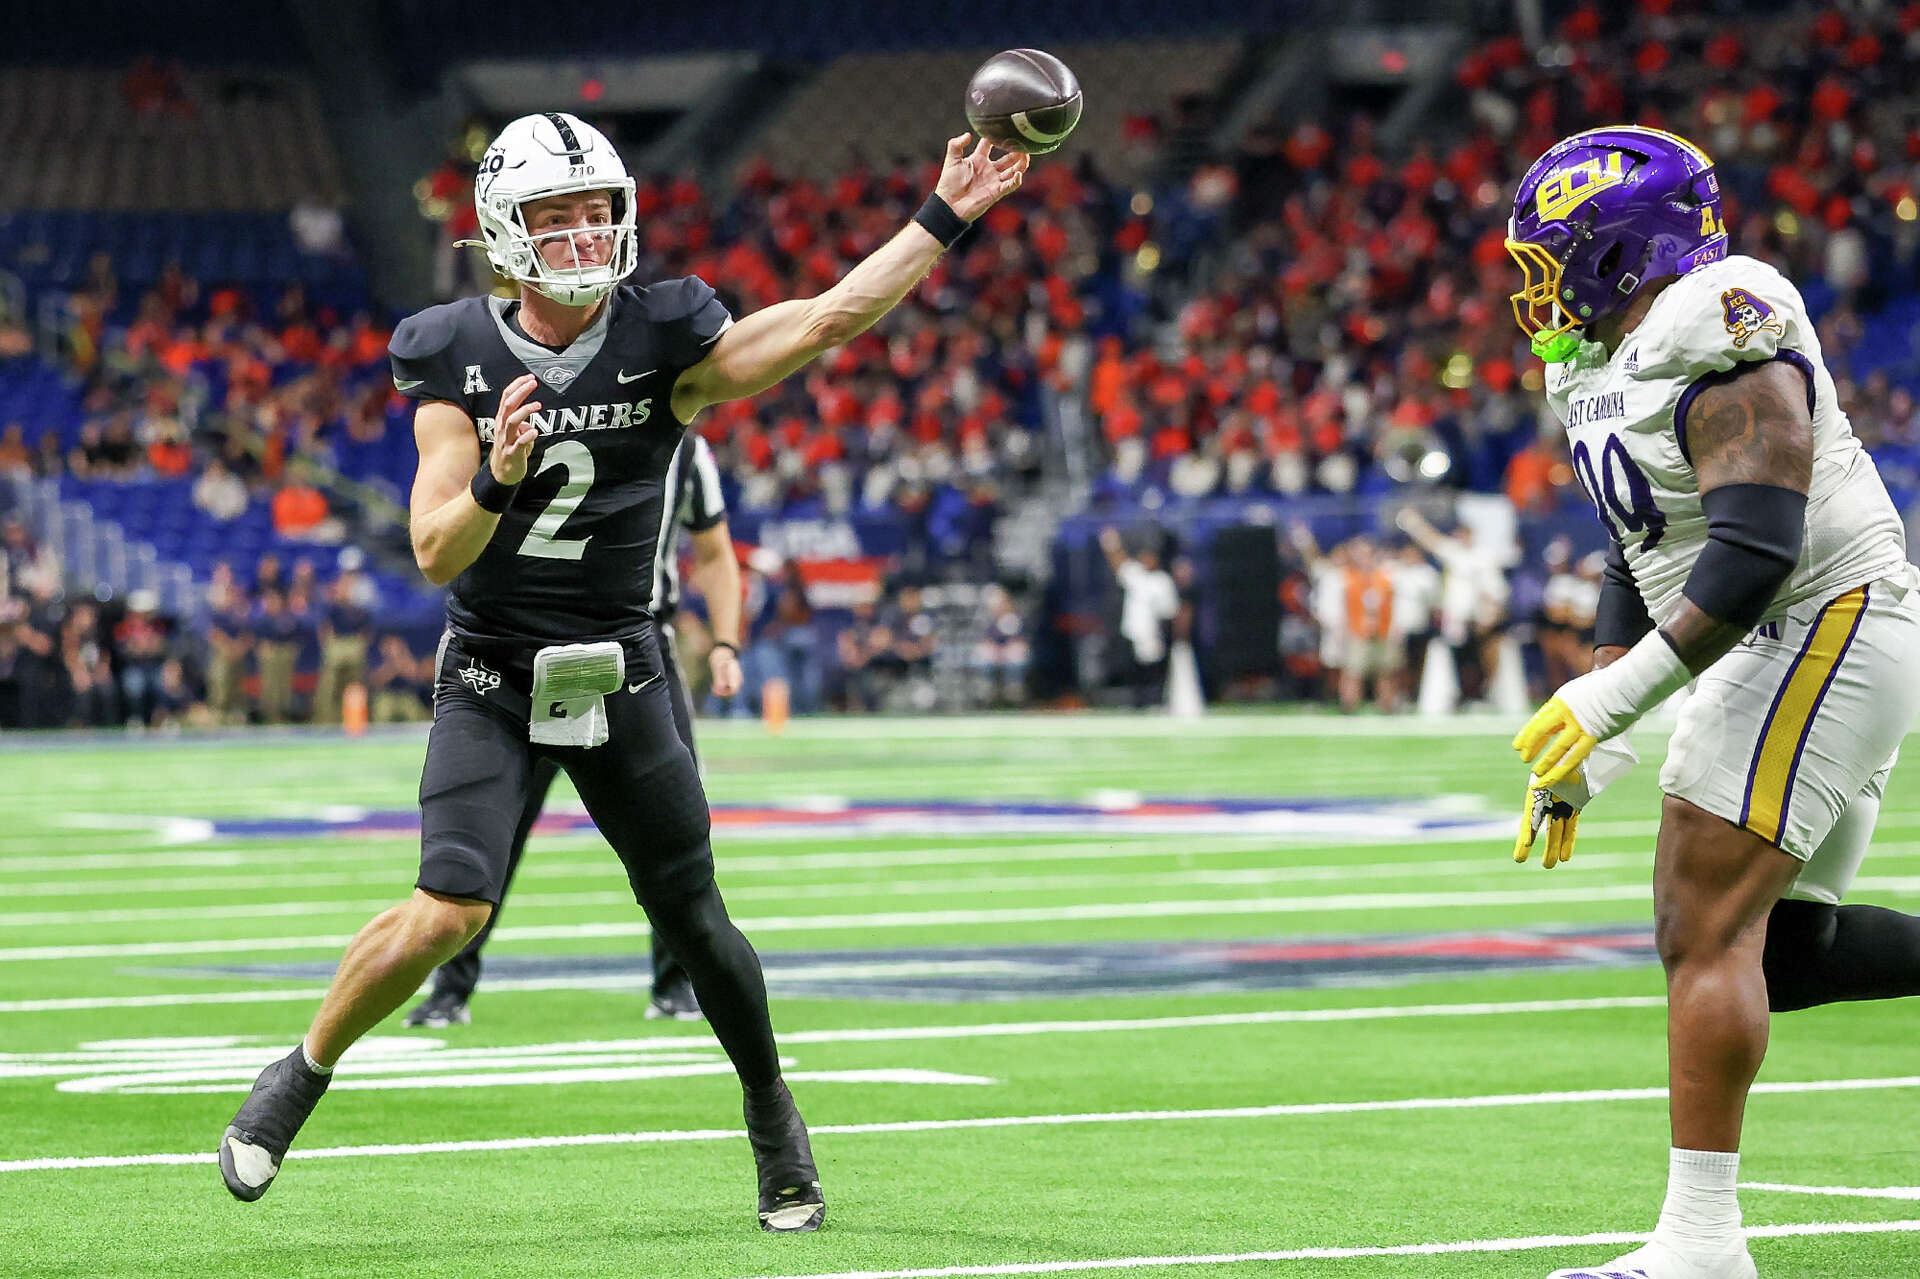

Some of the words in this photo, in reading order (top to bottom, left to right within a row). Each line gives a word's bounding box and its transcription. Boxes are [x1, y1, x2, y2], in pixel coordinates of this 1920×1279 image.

[568, 165, 595, 178] 210
[1536, 151, 1623, 218] ECU
[1693, 247, 1720, 266] EAST
[475, 398, 653, 444] RNNERS
[516, 440, 595, 561] 2
